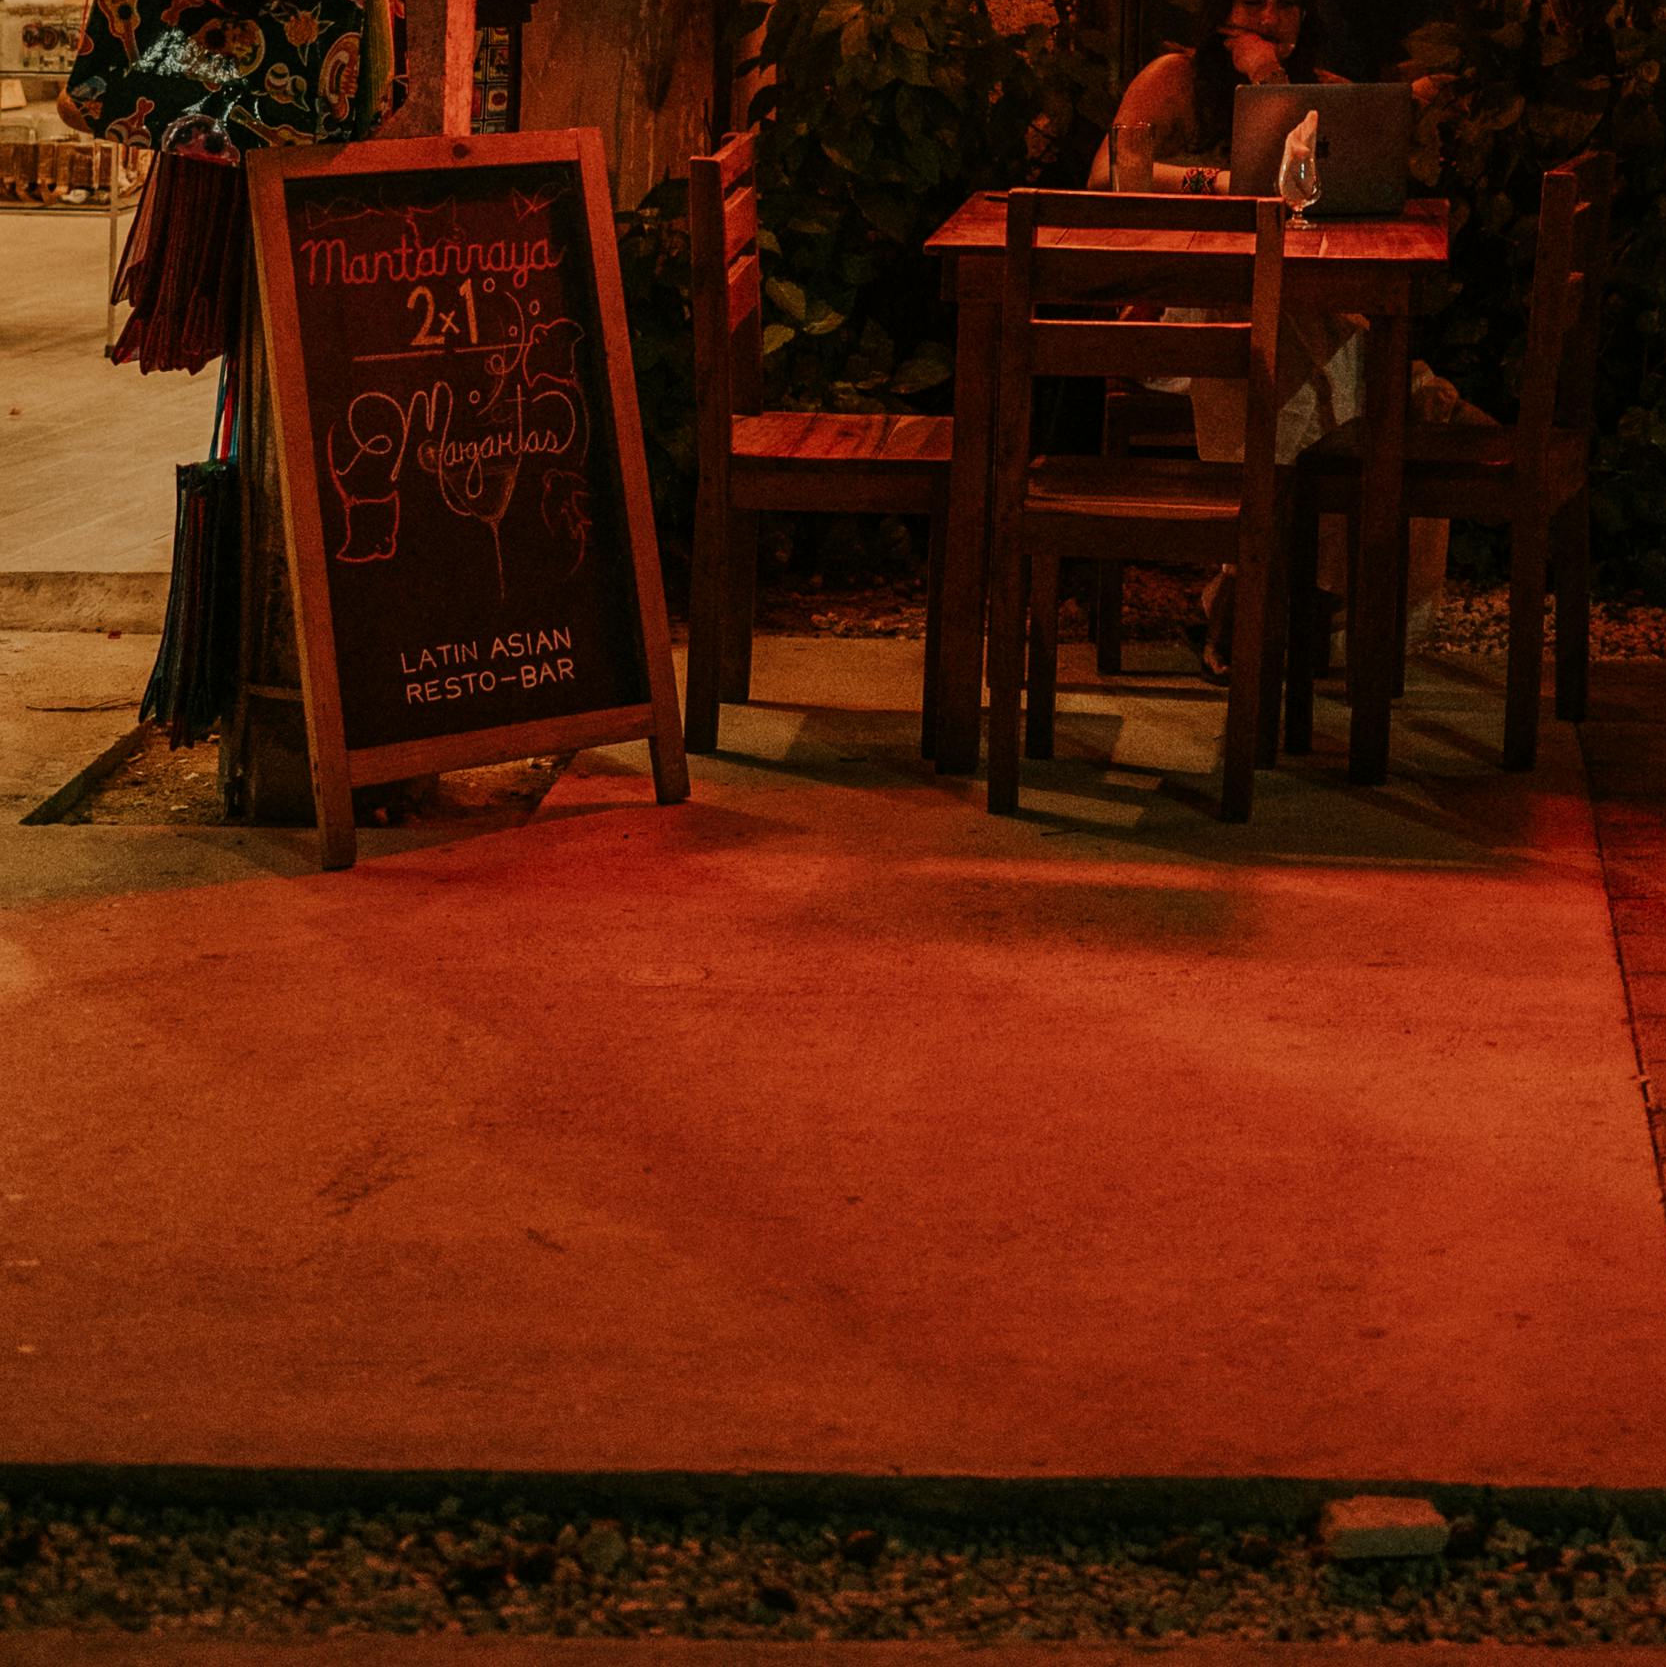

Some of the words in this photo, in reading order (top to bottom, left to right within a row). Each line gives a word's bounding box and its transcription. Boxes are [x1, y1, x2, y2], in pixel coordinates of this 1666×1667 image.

[300, 234, 563, 289] Mantarraya
[406, 277, 479, 346] 2x1
[336, 380, 576, 499] Margaritas
[400, 640, 479, 674] LATIN
[490, 626, 572, 660] ASIAN
[405, 657, 576, 705] RESTO-BAR
